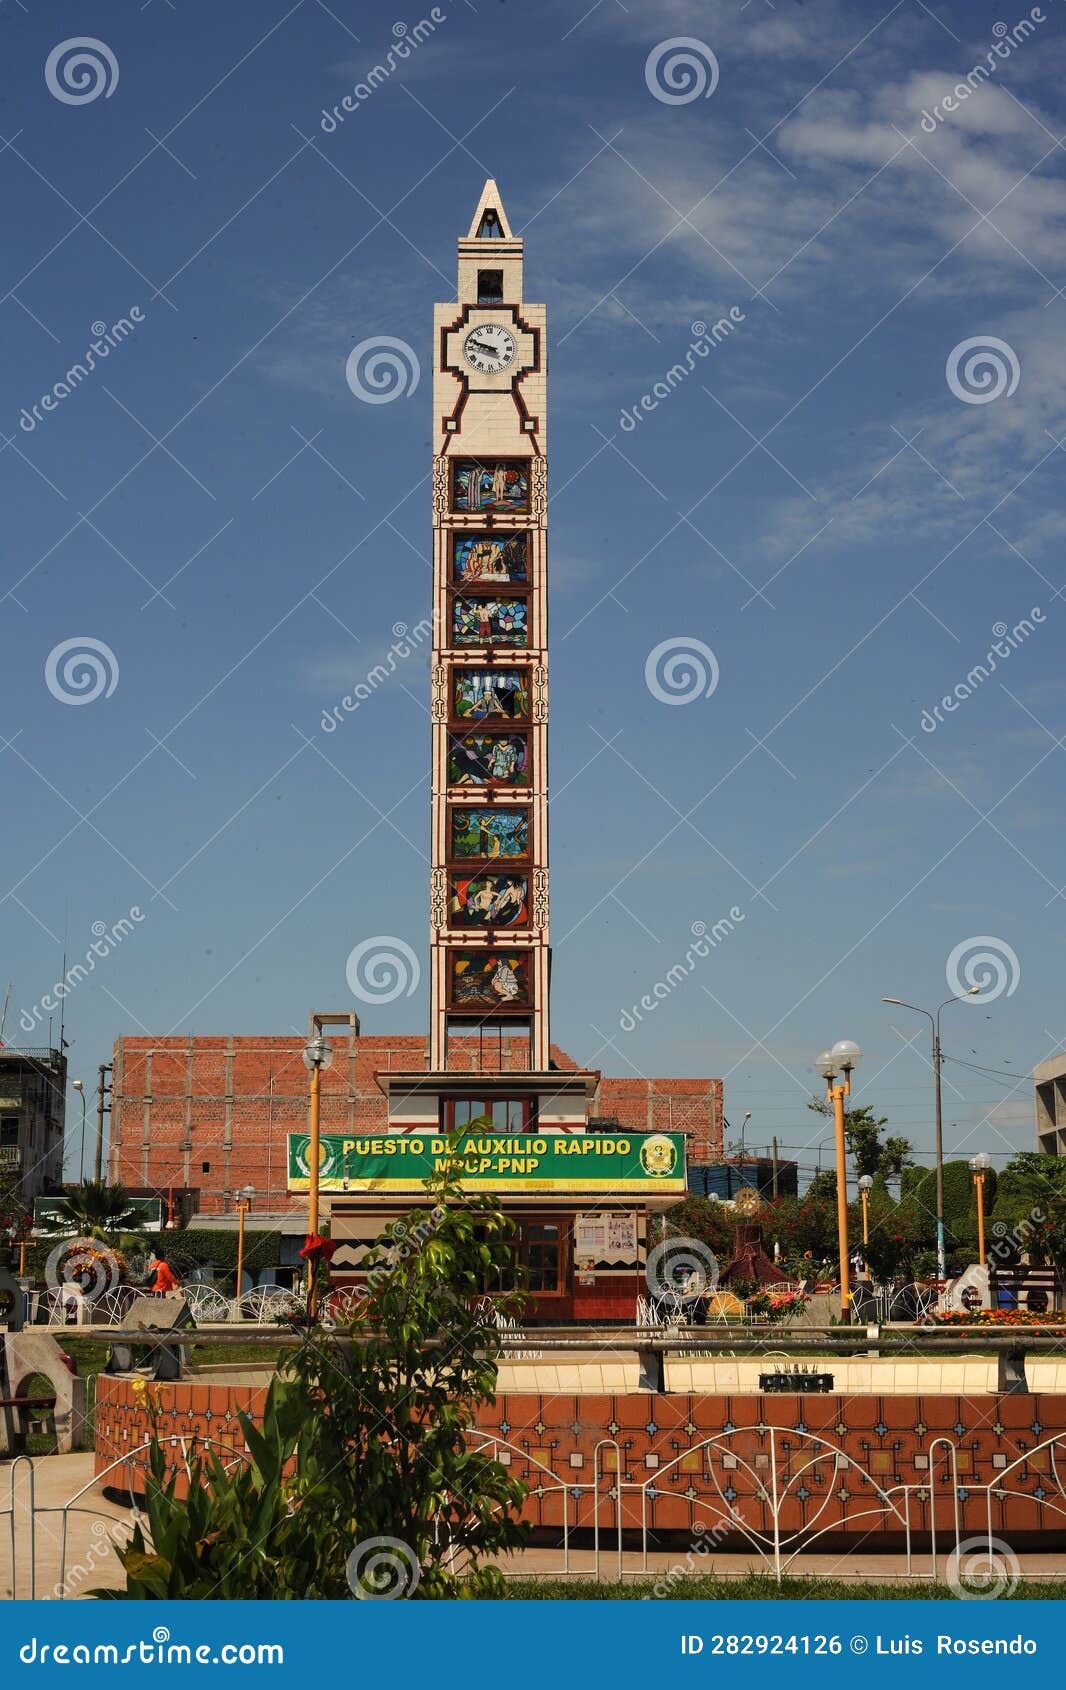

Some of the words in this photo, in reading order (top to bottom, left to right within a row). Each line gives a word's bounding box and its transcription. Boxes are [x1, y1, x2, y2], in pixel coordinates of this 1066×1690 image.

[343, 1139, 424, 1155] PUESTO
[463, 1139, 547, 1155] AUXILIO
[554, 1139, 631, 1155] RAPIDO
